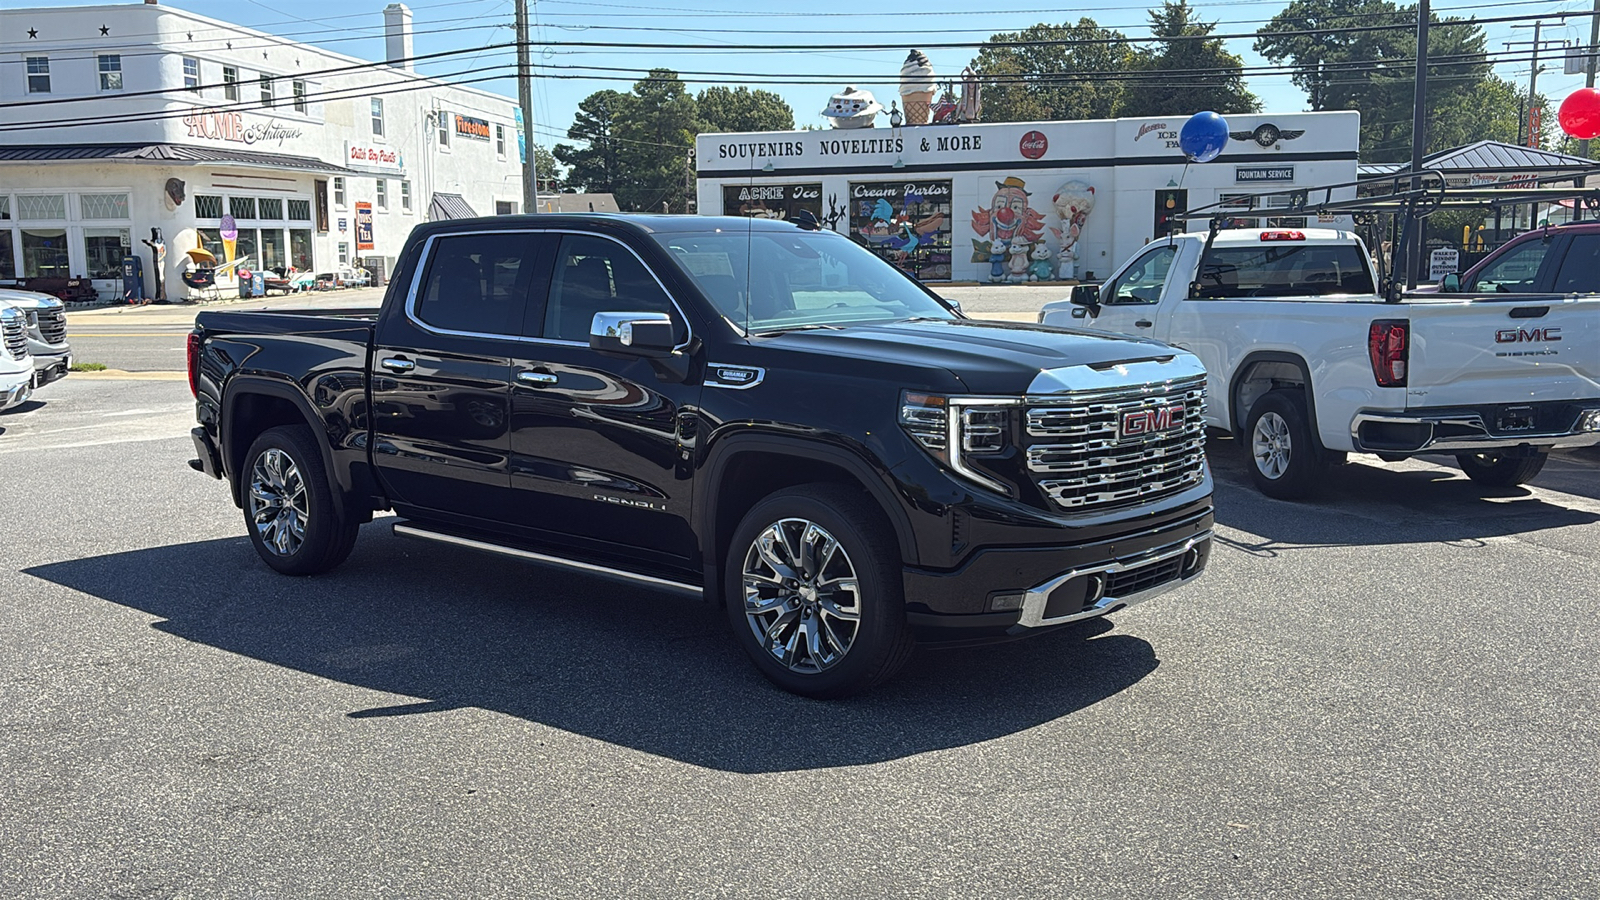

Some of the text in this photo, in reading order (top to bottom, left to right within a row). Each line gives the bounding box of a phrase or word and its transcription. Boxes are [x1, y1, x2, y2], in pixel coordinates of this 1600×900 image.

[183, 104, 244, 142] ACME
[1157, 131, 1177, 139] ICE
[719, 135, 982, 159] SOUVENIRS NOVELTIES & MORE
[368, 148, 379, 164] Boy
[380, 149, 396, 163] Paints
[1238, 169, 1292, 179] FOUNTAIN SERVICE
[739, 186, 820, 200] ACME Ice
[854, 183, 950, 198] Cream Parlor
[1495, 327, 1562, 343] GMC
[1123, 405, 1184, 436] GMC
[593, 494, 666, 511] DENALI
